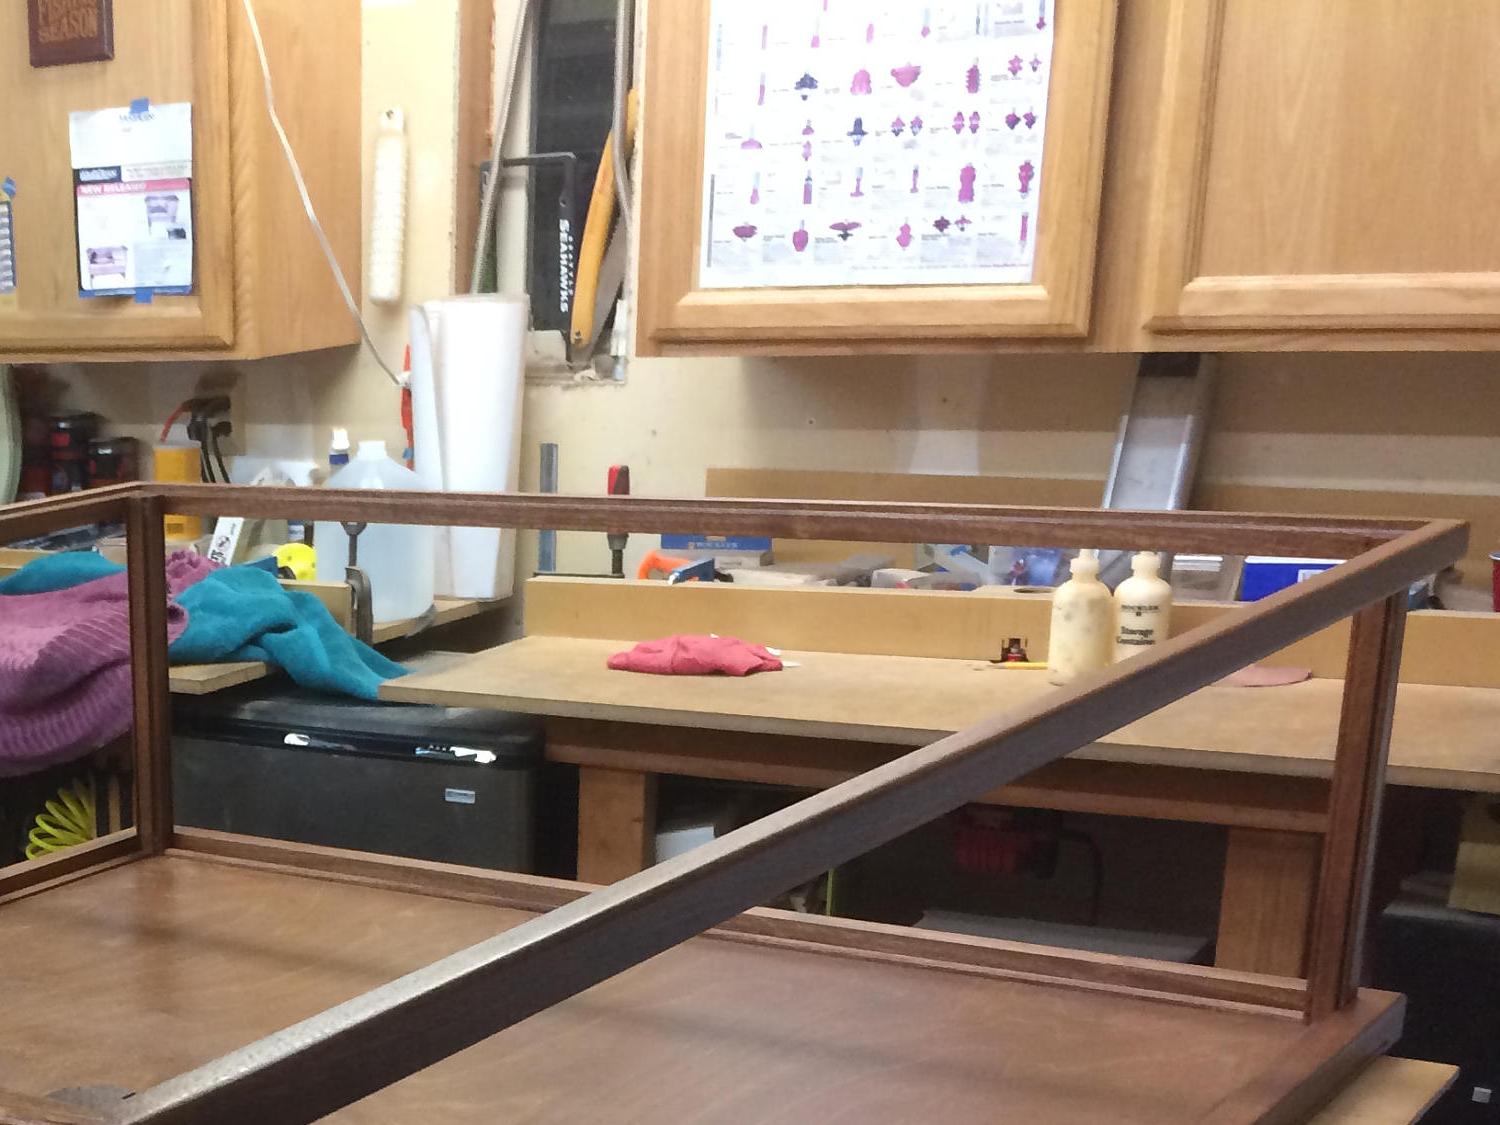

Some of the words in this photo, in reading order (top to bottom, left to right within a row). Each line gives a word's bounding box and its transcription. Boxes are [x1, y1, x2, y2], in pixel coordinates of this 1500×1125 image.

[37, 7, 100, 43] SEASON
[81, 184, 103, 195] NEW
[559, 218, 570, 313] SEAHAWKS
[1121, 626, 1154, 638] Storage
